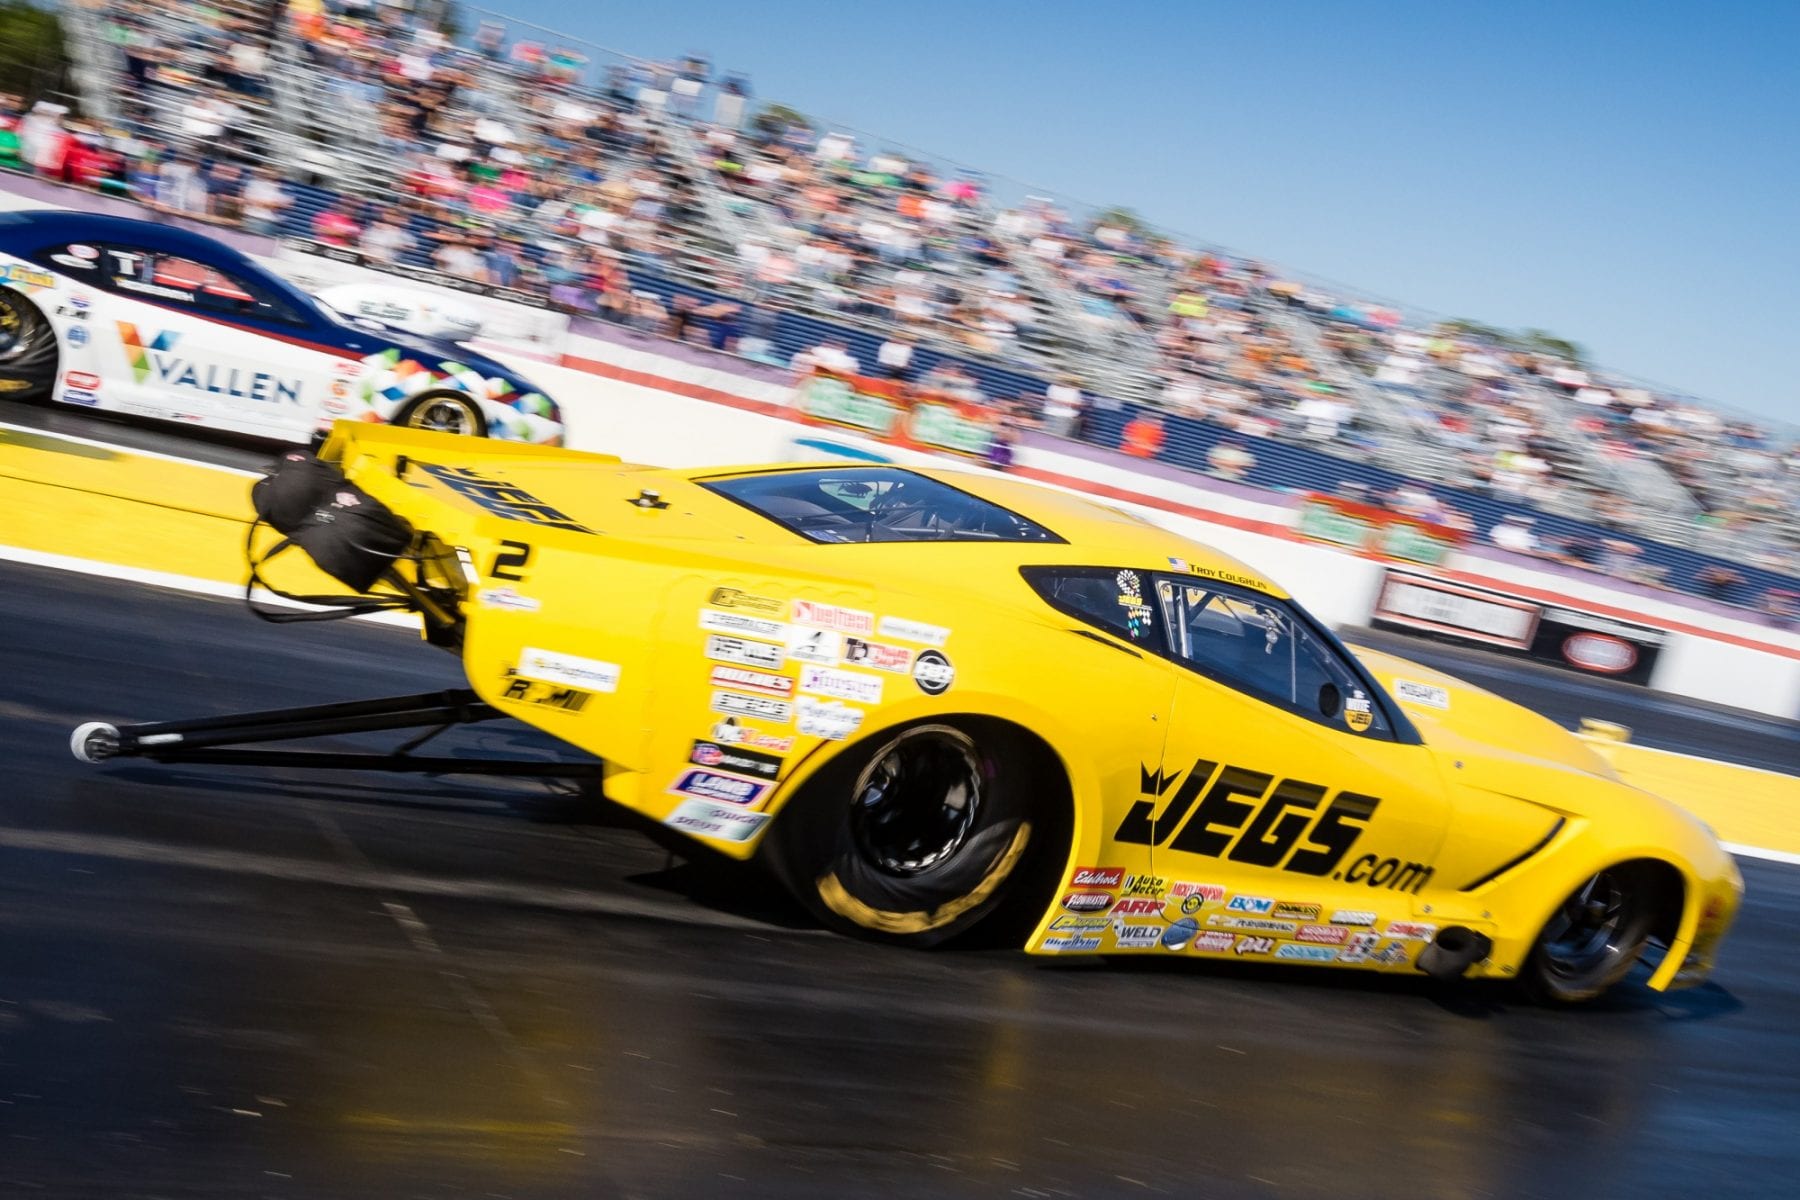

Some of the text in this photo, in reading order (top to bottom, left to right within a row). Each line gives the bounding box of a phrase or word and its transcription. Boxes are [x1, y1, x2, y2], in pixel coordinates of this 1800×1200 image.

[154, 354, 303, 405] VALLEN
[490, 539, 531, 582] 2
[1189, 564, 1268, 590] TROY COUGHLIN
[1073, 870, 1120, 885] Edelbrock
[1110, 899, 1167, 914] ARP
[1120, 926, 1162, 940] WELD
